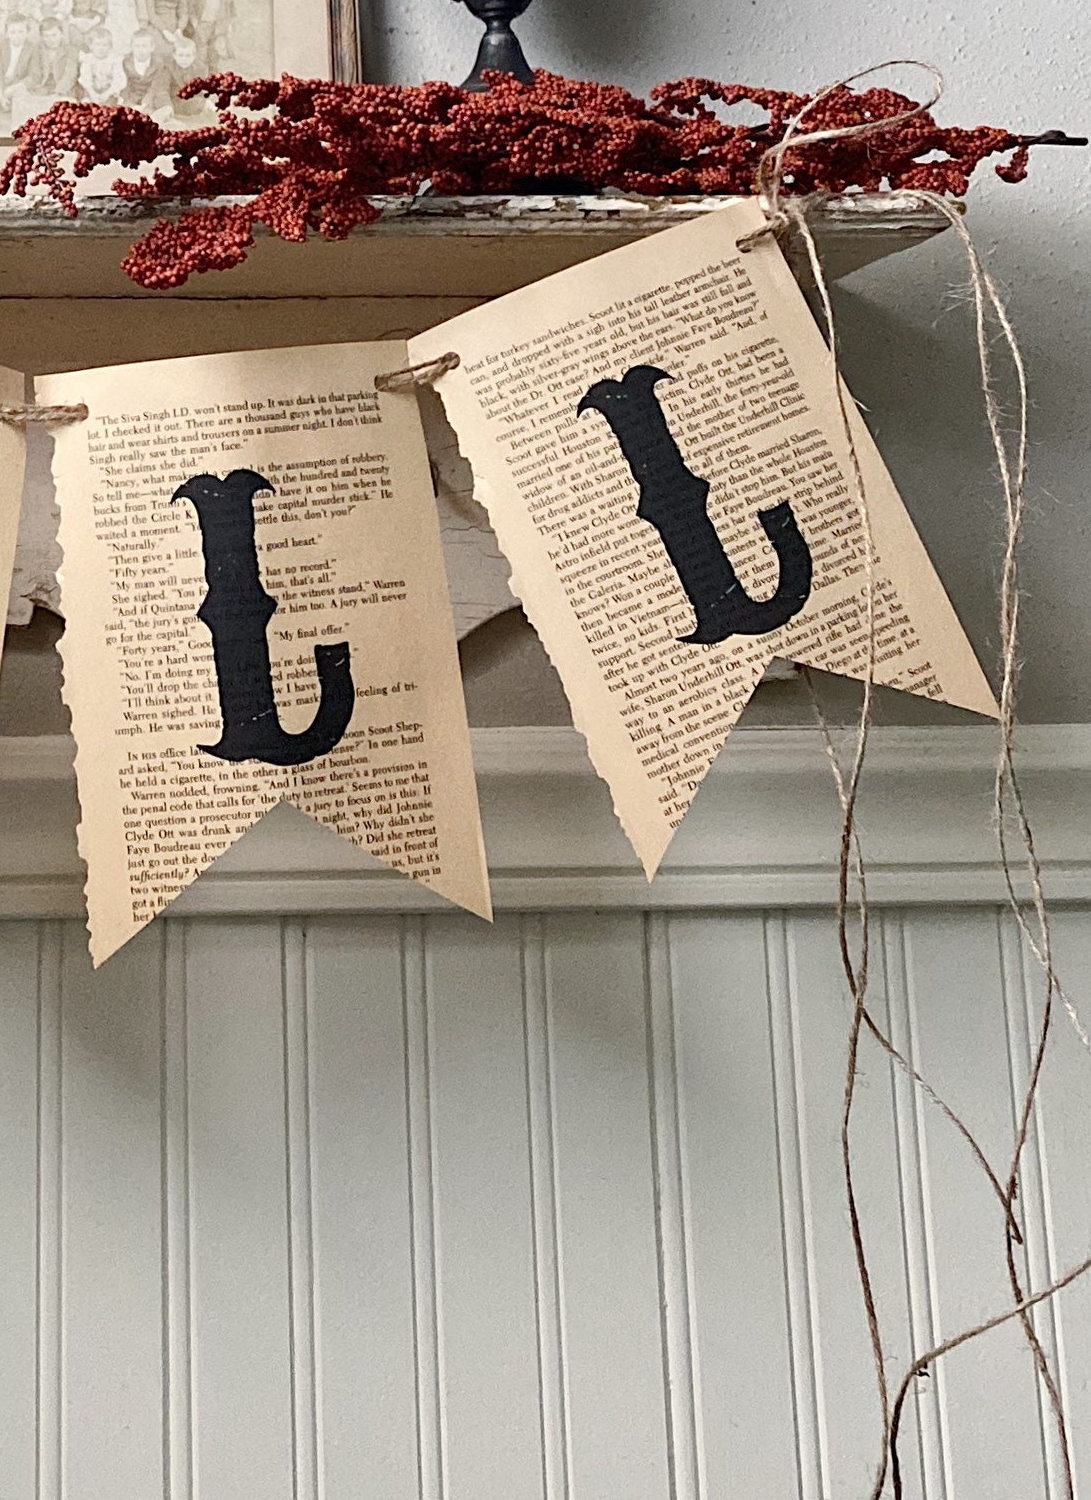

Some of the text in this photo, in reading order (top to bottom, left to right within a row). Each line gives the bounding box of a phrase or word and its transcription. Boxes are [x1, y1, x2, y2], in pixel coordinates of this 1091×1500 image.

[485, 354, 499, 366] for
[499, 342, 530, 359] turkey
[532, 319, 589, 346] sandwiches.
[588, 305, 615, 322] Scoot
[614, 301, 627, 312] lit
[673, 268, 707, 291] popped
[706, 264, 722, 275] the
[720, 256, 741, 269] beer
[485, 403, 512, 420] about
[512, 397, 528, 408] the
[546, 381, 564, 394] Ott
[564, 368, 589, 387] case?
[592, 359, 612, 375] And
[612, 356, 627, 367] my
[629, 344, 655, 360] client
[654, 331, 691, 352] Johnnie
[690, 321, 713, 335] Faye
[120, 414, 141, 423] Siva
[142, 408, 171, 422] Singh
[193, 403, 221, 415] won't
[222, 399, 249, 413] stand
[250, 401, 266, 412] up.
[267, 398, 276, 409] It
[277, 398, 295, 407] was
[295, 393, 317, 406] dark
[317, 394, 328, 404] in
[328, 391, 346, 403] that
[346, 389, 379, 404] parking
[125, 463, 157, 475] claims
[159, 459, 176, 471] she
[577, 365, 813, 646] L
[170, 469, 356, 766] L
[677, 708, 700, 722] man
[701, 703, 713, 713] in
[722, 684, 751, 703] black
[130, 791, 166, 801] Warren
[169, 784, 210, 798] nodded,
[300, 774, 327, 786] know
[329, 767, 361, 782] there's
[371, 763, 415, 779] provision
[417, 760, 428, 770] in
